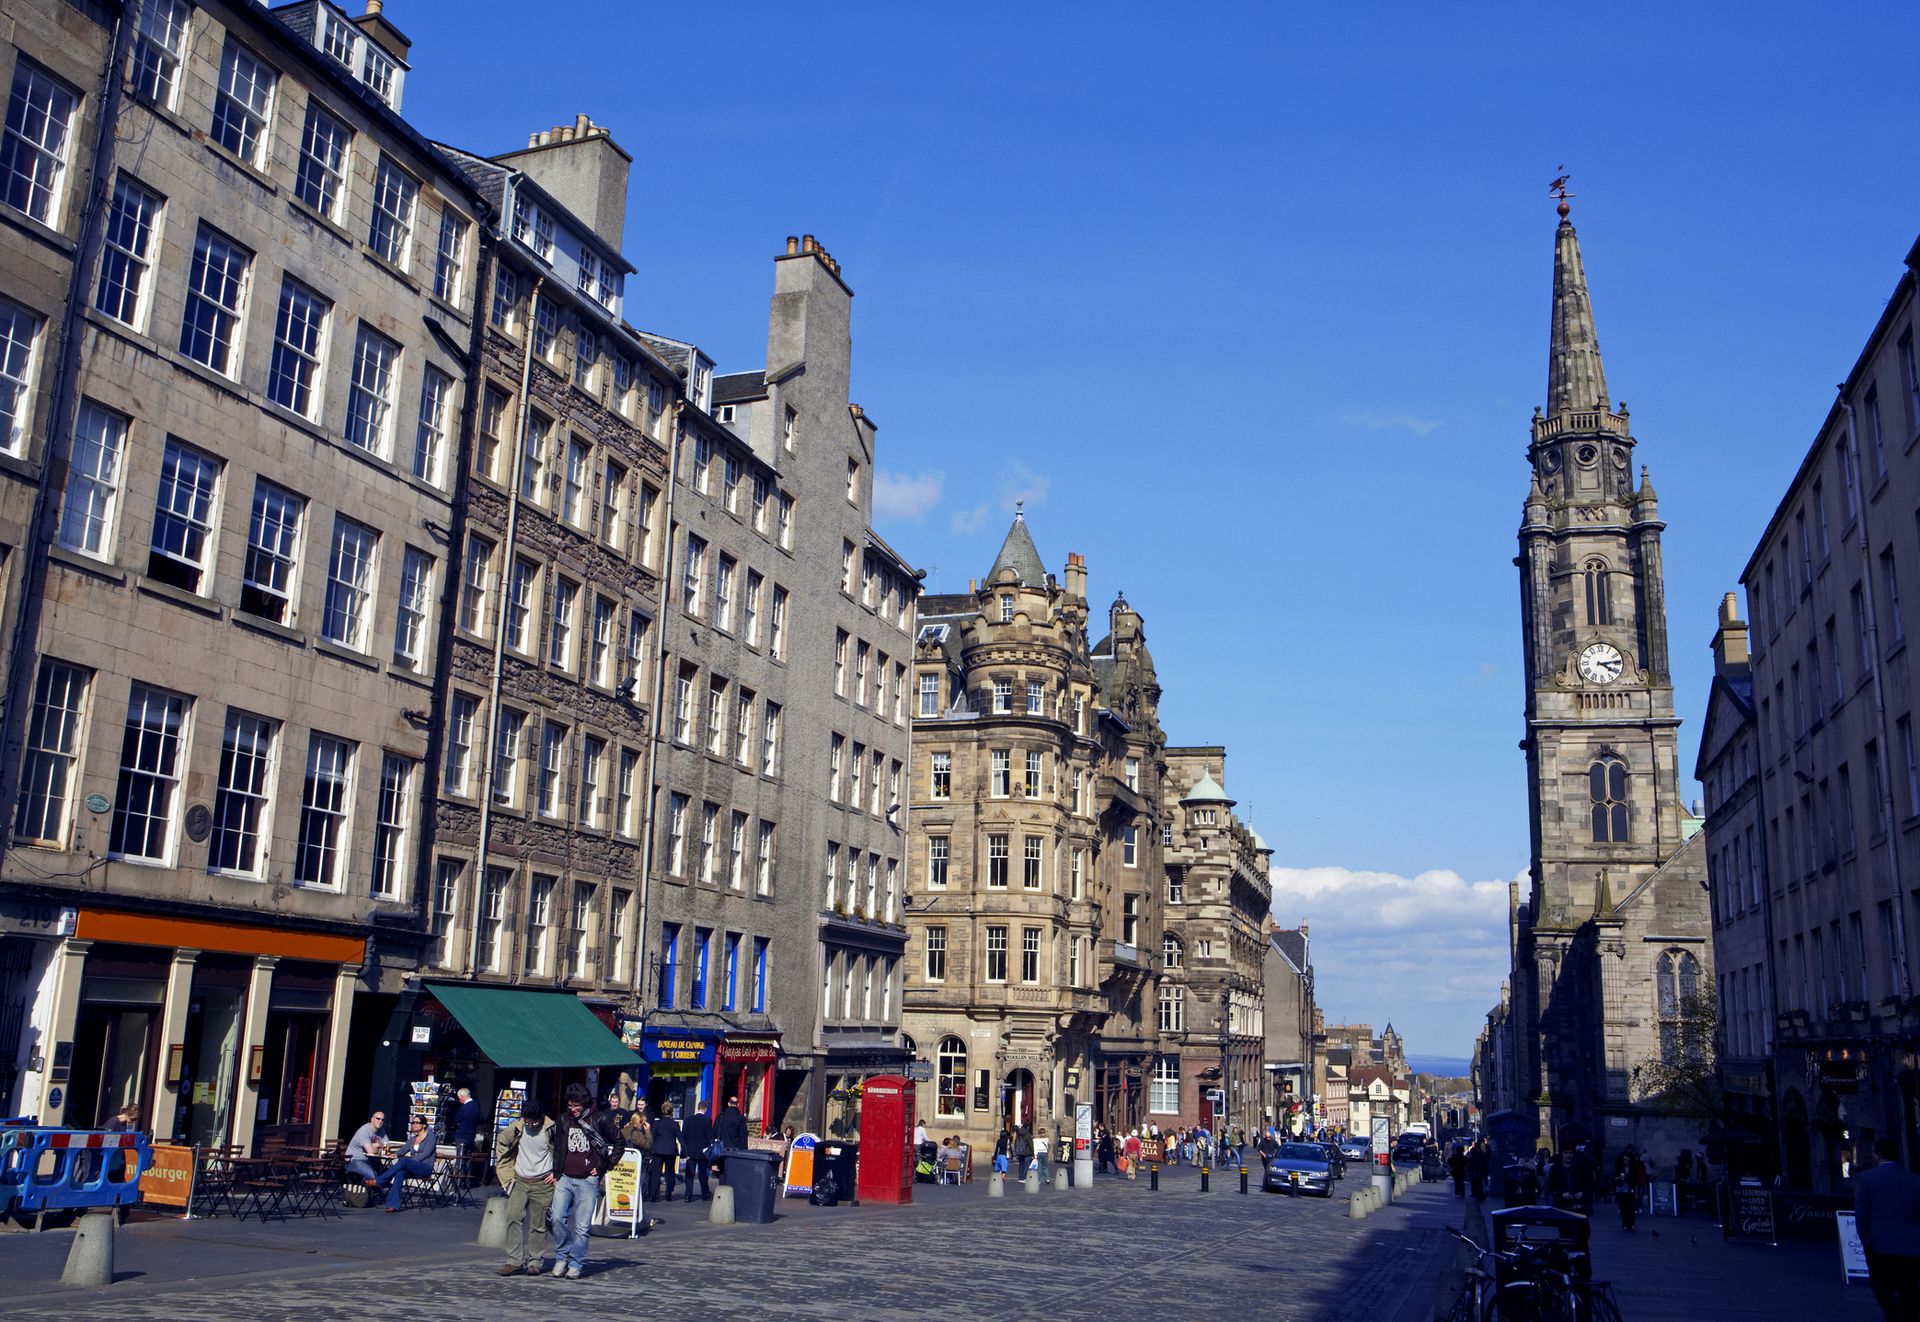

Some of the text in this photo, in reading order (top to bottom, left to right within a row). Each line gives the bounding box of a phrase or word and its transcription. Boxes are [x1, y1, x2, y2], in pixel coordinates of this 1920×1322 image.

[20, 907, 51, 928] 219
[657, 1040, 678, 1048] BUREAU
[678, 1041, 685, 1049] DE
[1141, 1142, 1158, 1150] ELLA
